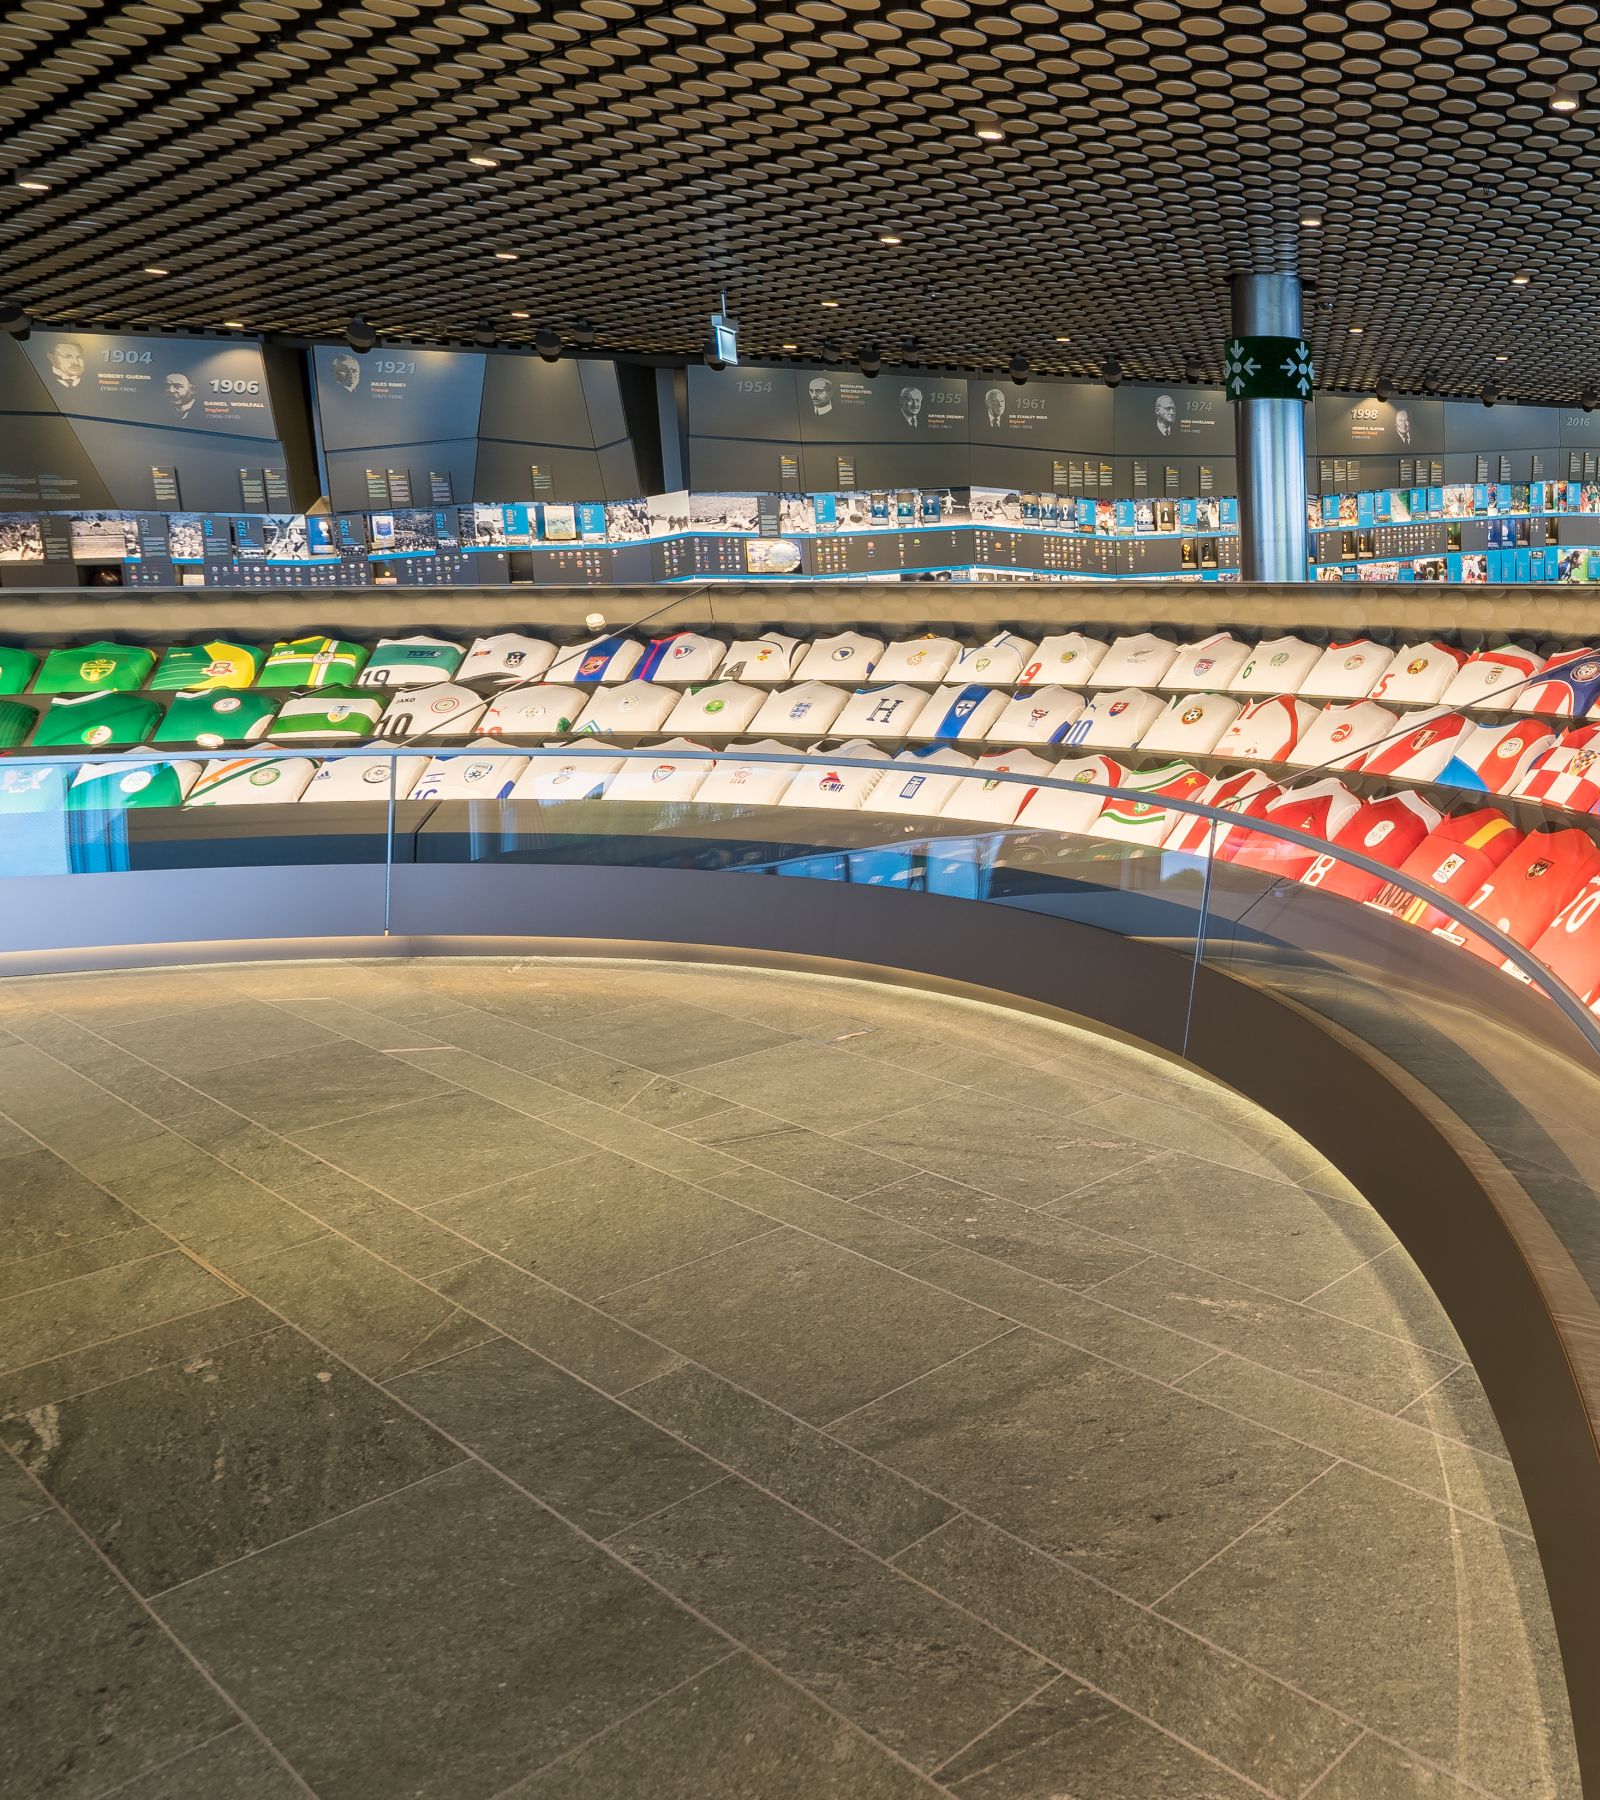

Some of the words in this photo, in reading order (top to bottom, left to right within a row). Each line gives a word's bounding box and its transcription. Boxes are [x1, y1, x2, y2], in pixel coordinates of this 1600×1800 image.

[101, 350, 152, 364] 1904
[375, 360, 416, 374] 1921
[209, 380, 260, 394] 1906
[736, 380, 772, 393] 1954
[928, 392, 962, 404] 1955
[1016, 398, 1046, 409] 1961
[1186, 400, 1212, 412] 1974
[1351, 408, 1378, 420] 1998
[1566, 416, 1590, 427] 2016
[141, 518, 150, 534] 1902
[204, 519, 213, 536] 1906
[236, 520, 247, 537] 1912
[340, 520, 348, 536] 1920
[1019, 662, 1042, 684] 9
[1242, 660, 1256, 679] 6
[1372, 674, 1396, 698] 5
[866, 698, 904, 723] H
[378, 712, 413, 736] 10
[1064, 719, 1094, 744] 10
